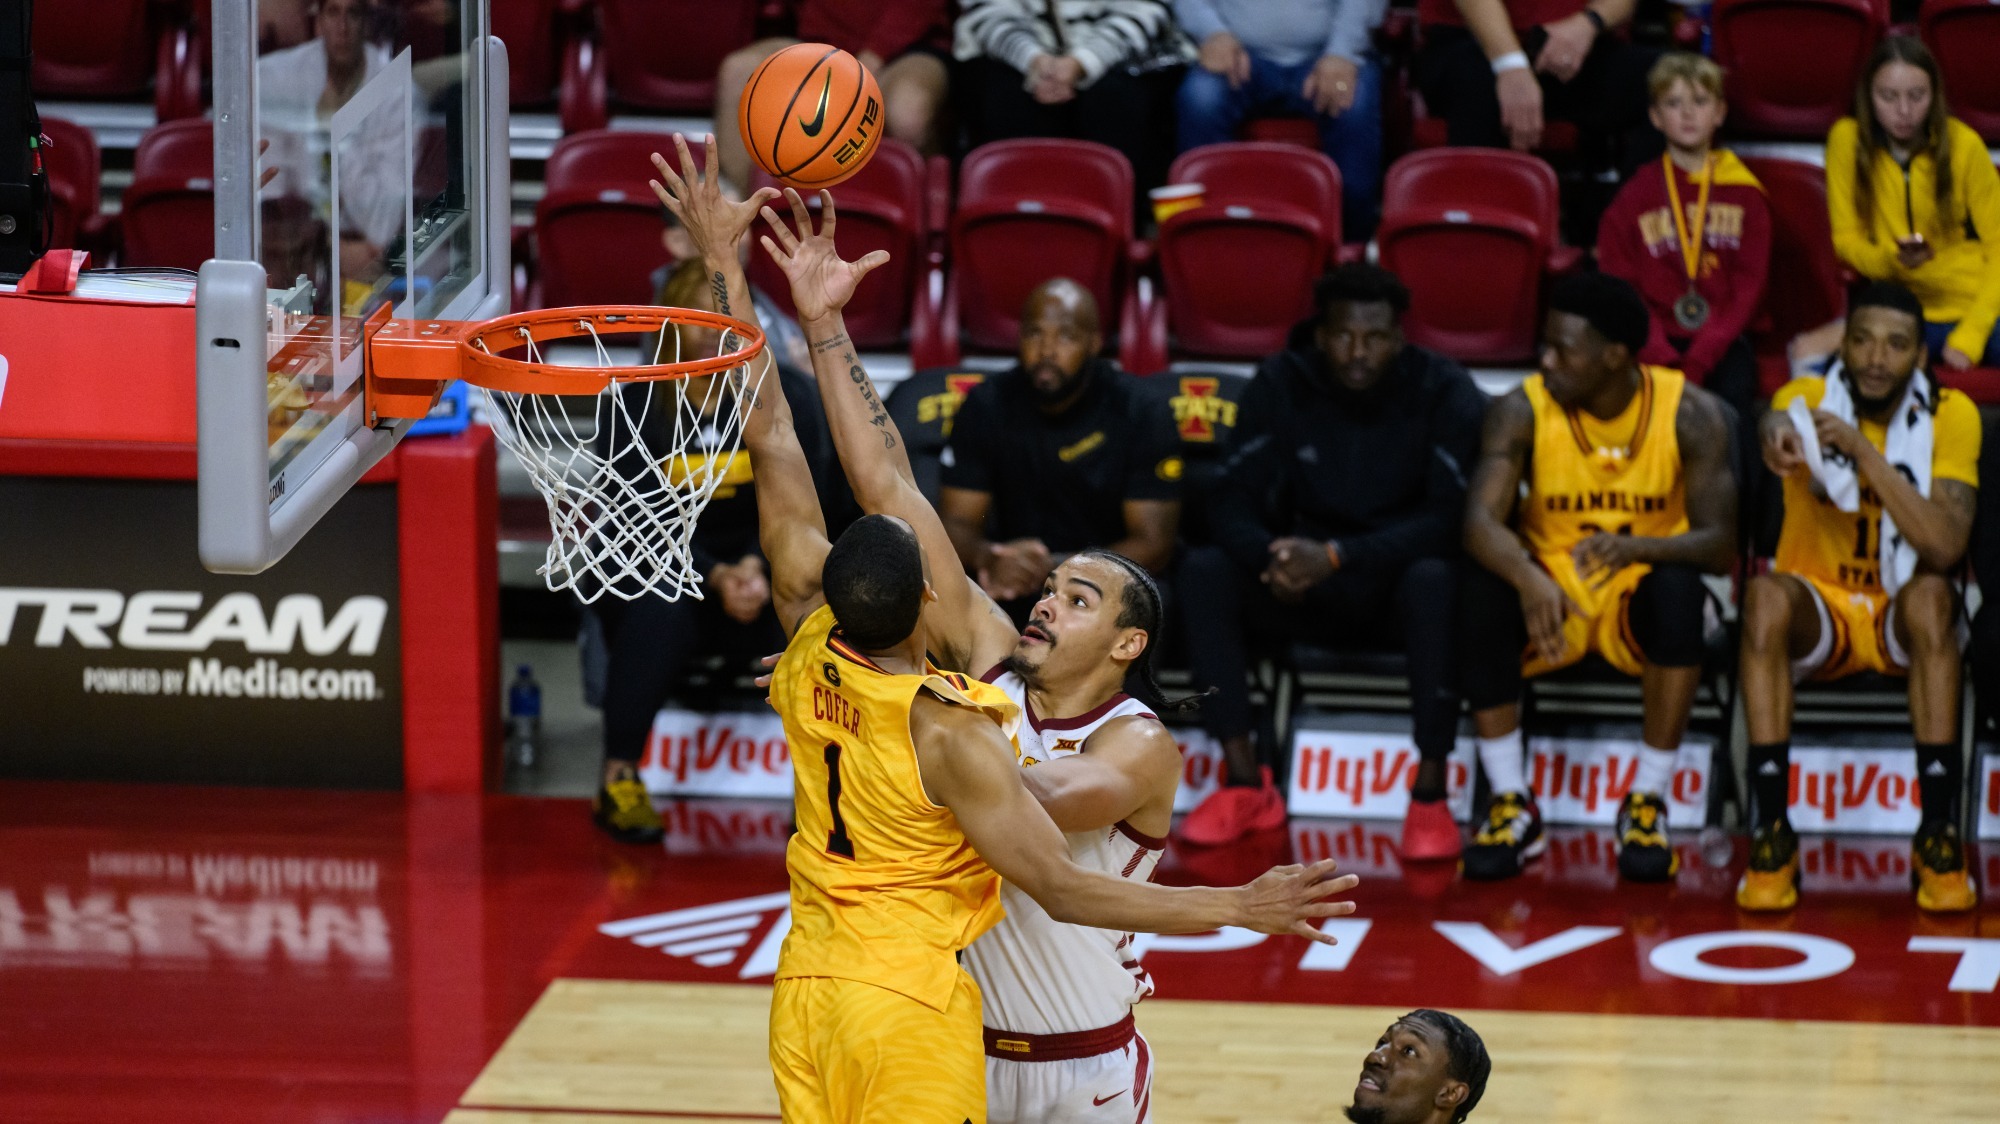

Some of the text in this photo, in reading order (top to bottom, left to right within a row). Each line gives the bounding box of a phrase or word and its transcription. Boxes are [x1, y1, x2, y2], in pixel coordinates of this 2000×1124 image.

[832, 95, 879, 166] ELITE
[1168, 396, 1238, 428] TATE
[83, 658, 377, 700] POWERED BY Mediacom
[813, 686, 861, 738] COFER
[1050, 737, 1083, 752] XII
[823, 740, 856, 862] 1
[1531, 752, 1702, 813] HyVe
